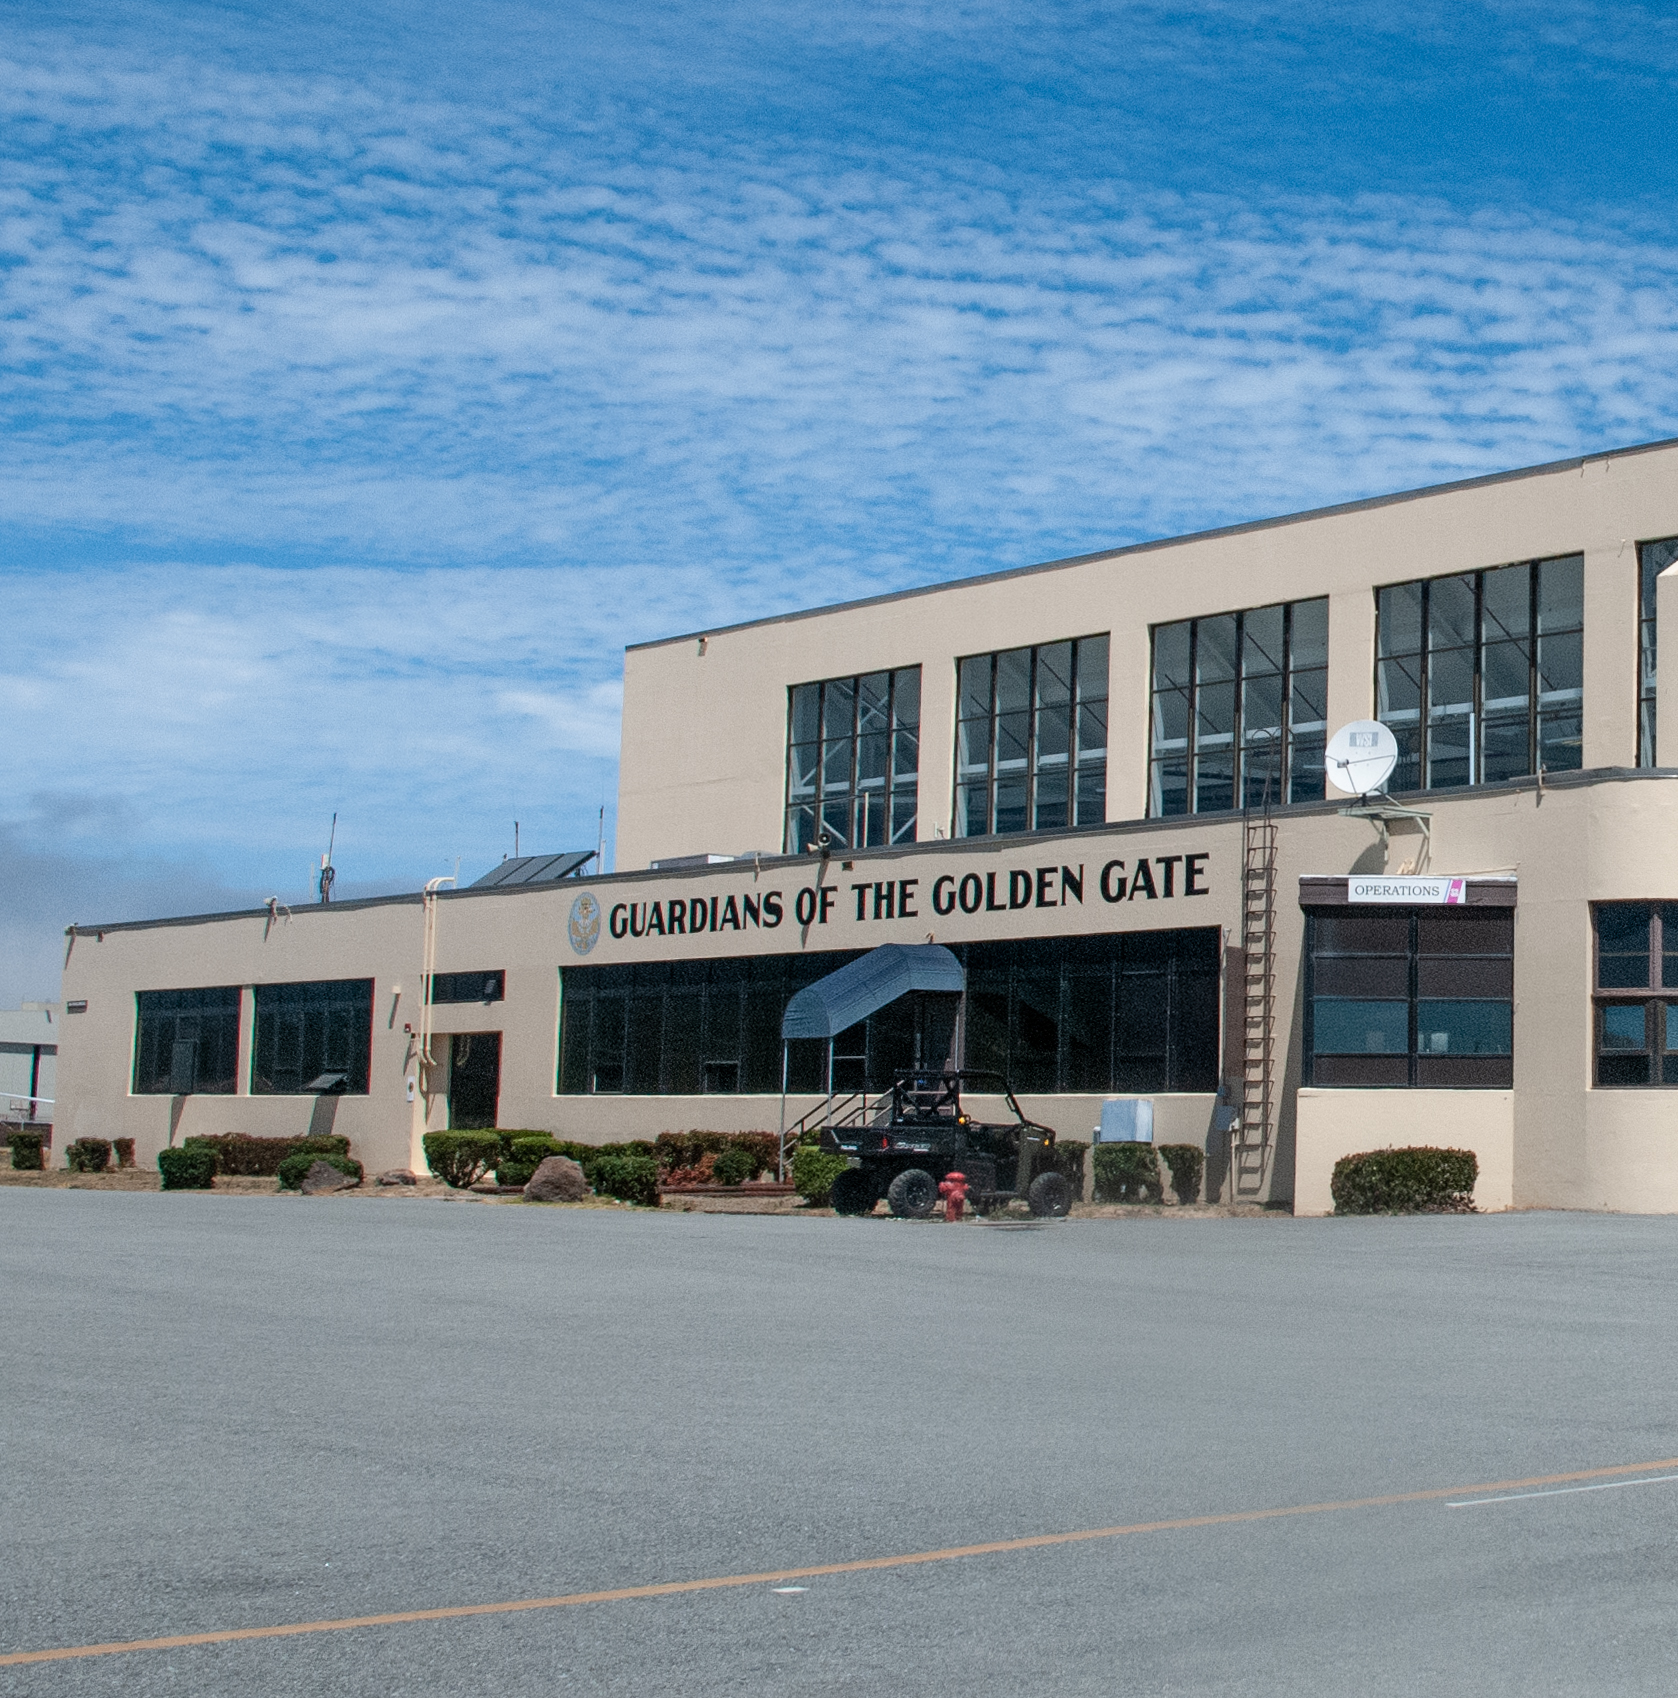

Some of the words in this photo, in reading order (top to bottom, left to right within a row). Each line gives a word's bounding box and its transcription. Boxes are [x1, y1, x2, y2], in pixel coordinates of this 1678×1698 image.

[609, 890, 783, 939] GUARDIANS
[796, 885, 837, 926] OF
[852, 878, 919, 921] THE
[933, 864, 1084, 916] GOLDEN
[1100, 852, 1210, 904] GATE
[1354, 884, 1440, 897] OPERATIONS
